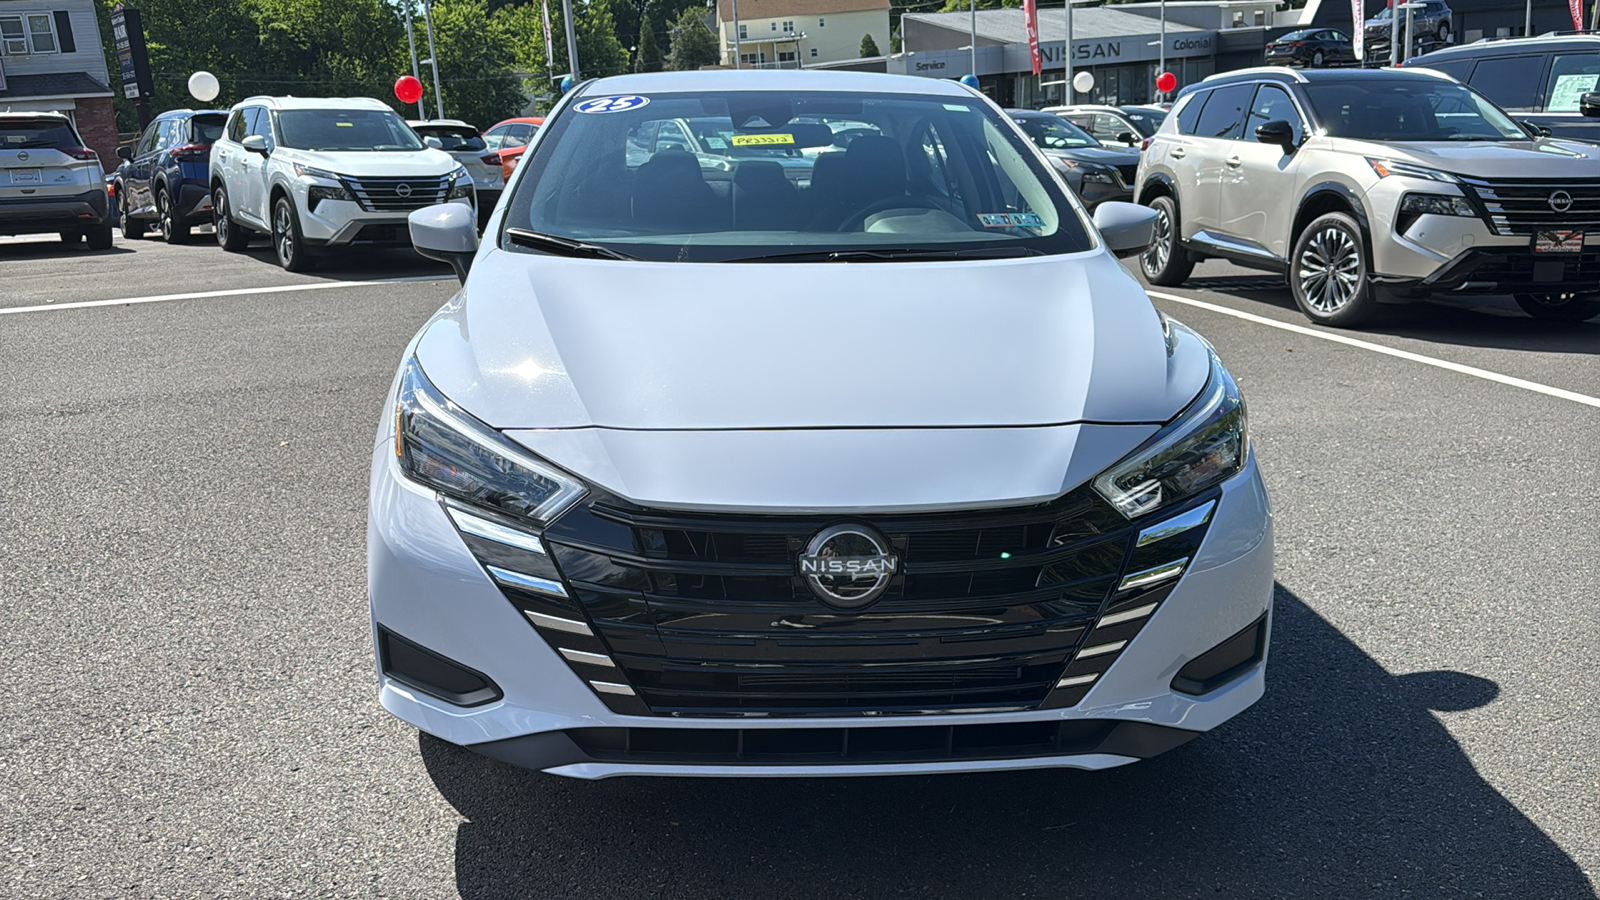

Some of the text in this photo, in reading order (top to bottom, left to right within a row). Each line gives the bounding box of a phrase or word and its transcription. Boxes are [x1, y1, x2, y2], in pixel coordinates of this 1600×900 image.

[1174, 37, 1212, 51] Colonial
[1041, 42, 1120, 63] NISSAN
[916, 60, 946, 71] Service
[585, 96, 636, 113] 25
[802, 558, 895, 573] NISSAN
